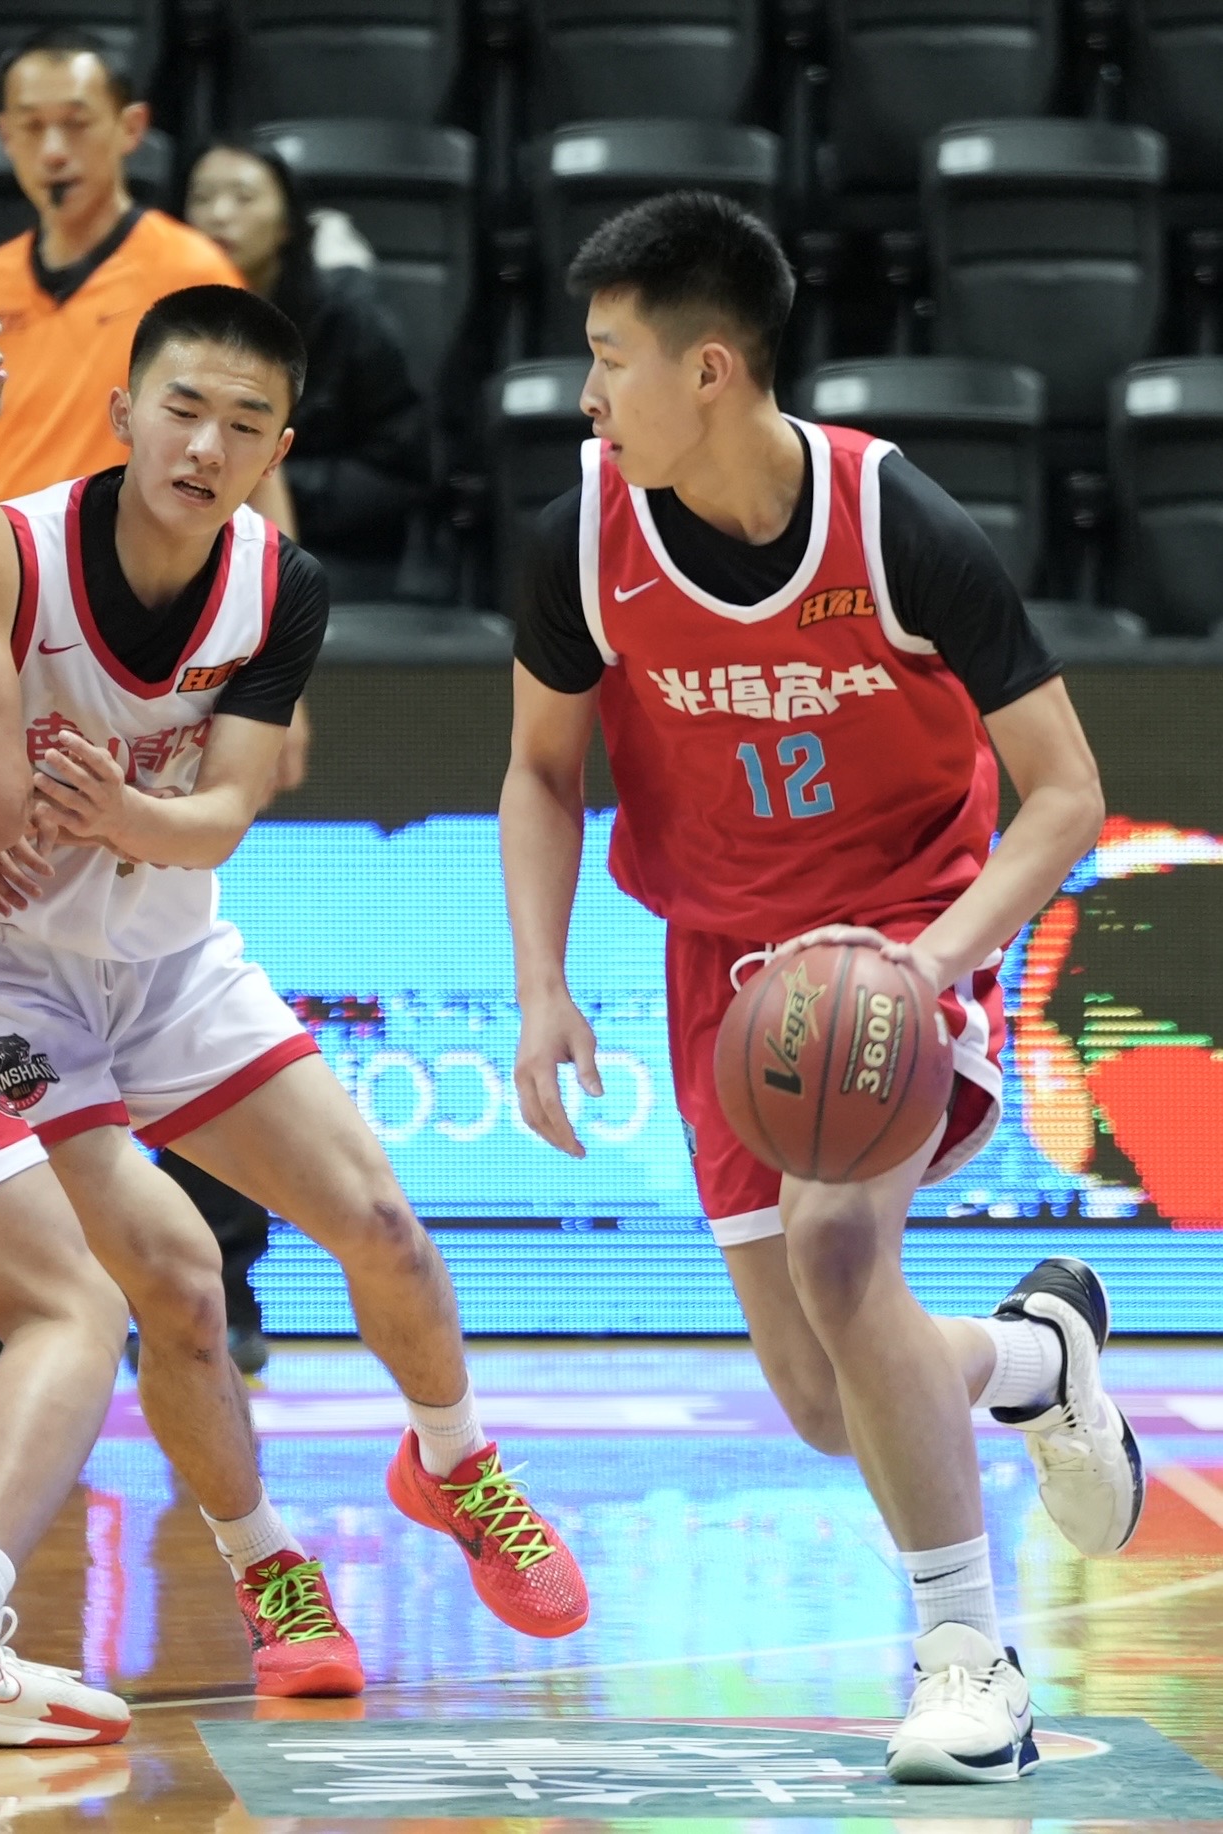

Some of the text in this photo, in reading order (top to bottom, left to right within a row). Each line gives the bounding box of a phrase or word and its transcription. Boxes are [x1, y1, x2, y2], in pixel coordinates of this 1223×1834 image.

[646, 661, 898, 722] 光復高中
[736, 730, 835, 819] 12
[763, 990, 808, 1099] Vega
[856, 993, 893, 1095] 3600
